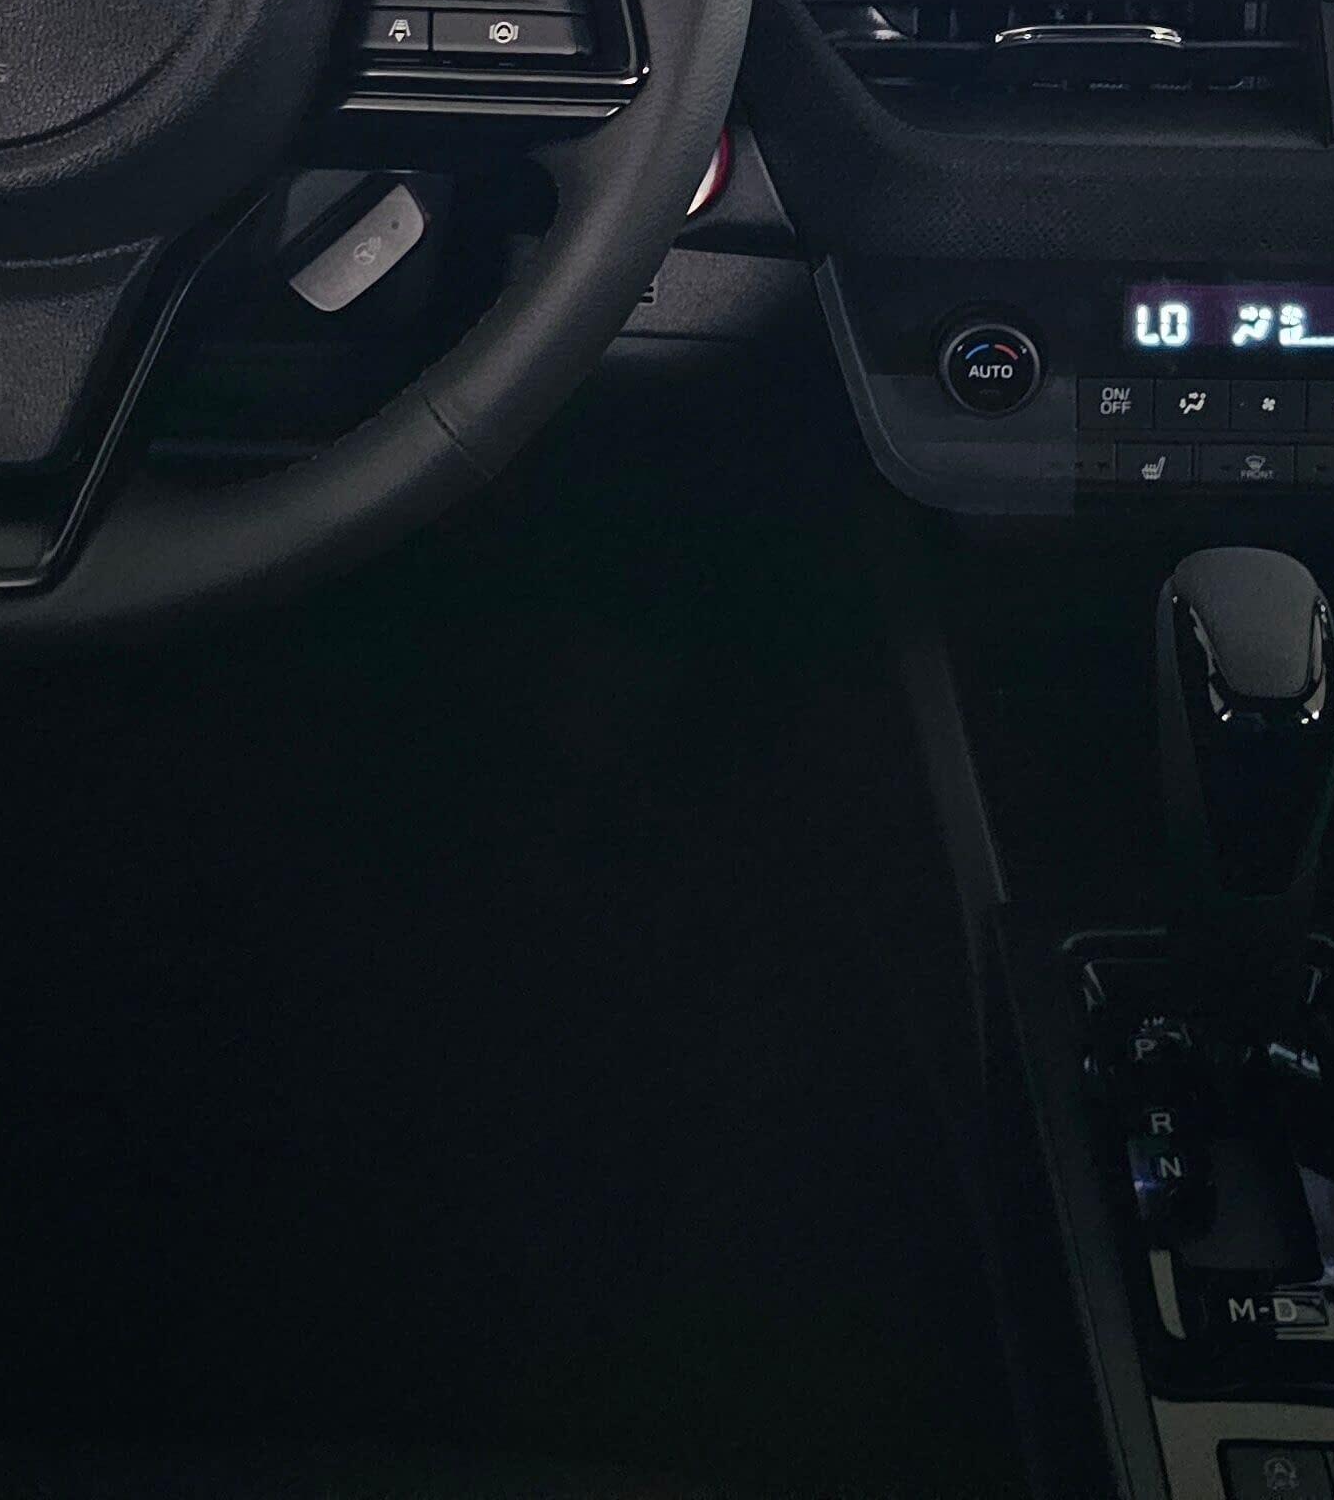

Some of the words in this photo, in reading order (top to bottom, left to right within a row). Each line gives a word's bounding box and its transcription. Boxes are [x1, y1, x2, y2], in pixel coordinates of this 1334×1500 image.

[967, 364, 1014, 379] AUTO
[1100, 400, 1132, 415] OFF
[1150, 1111, 1174, 1135] R
[1159, 1155, 1183, 1179] N
